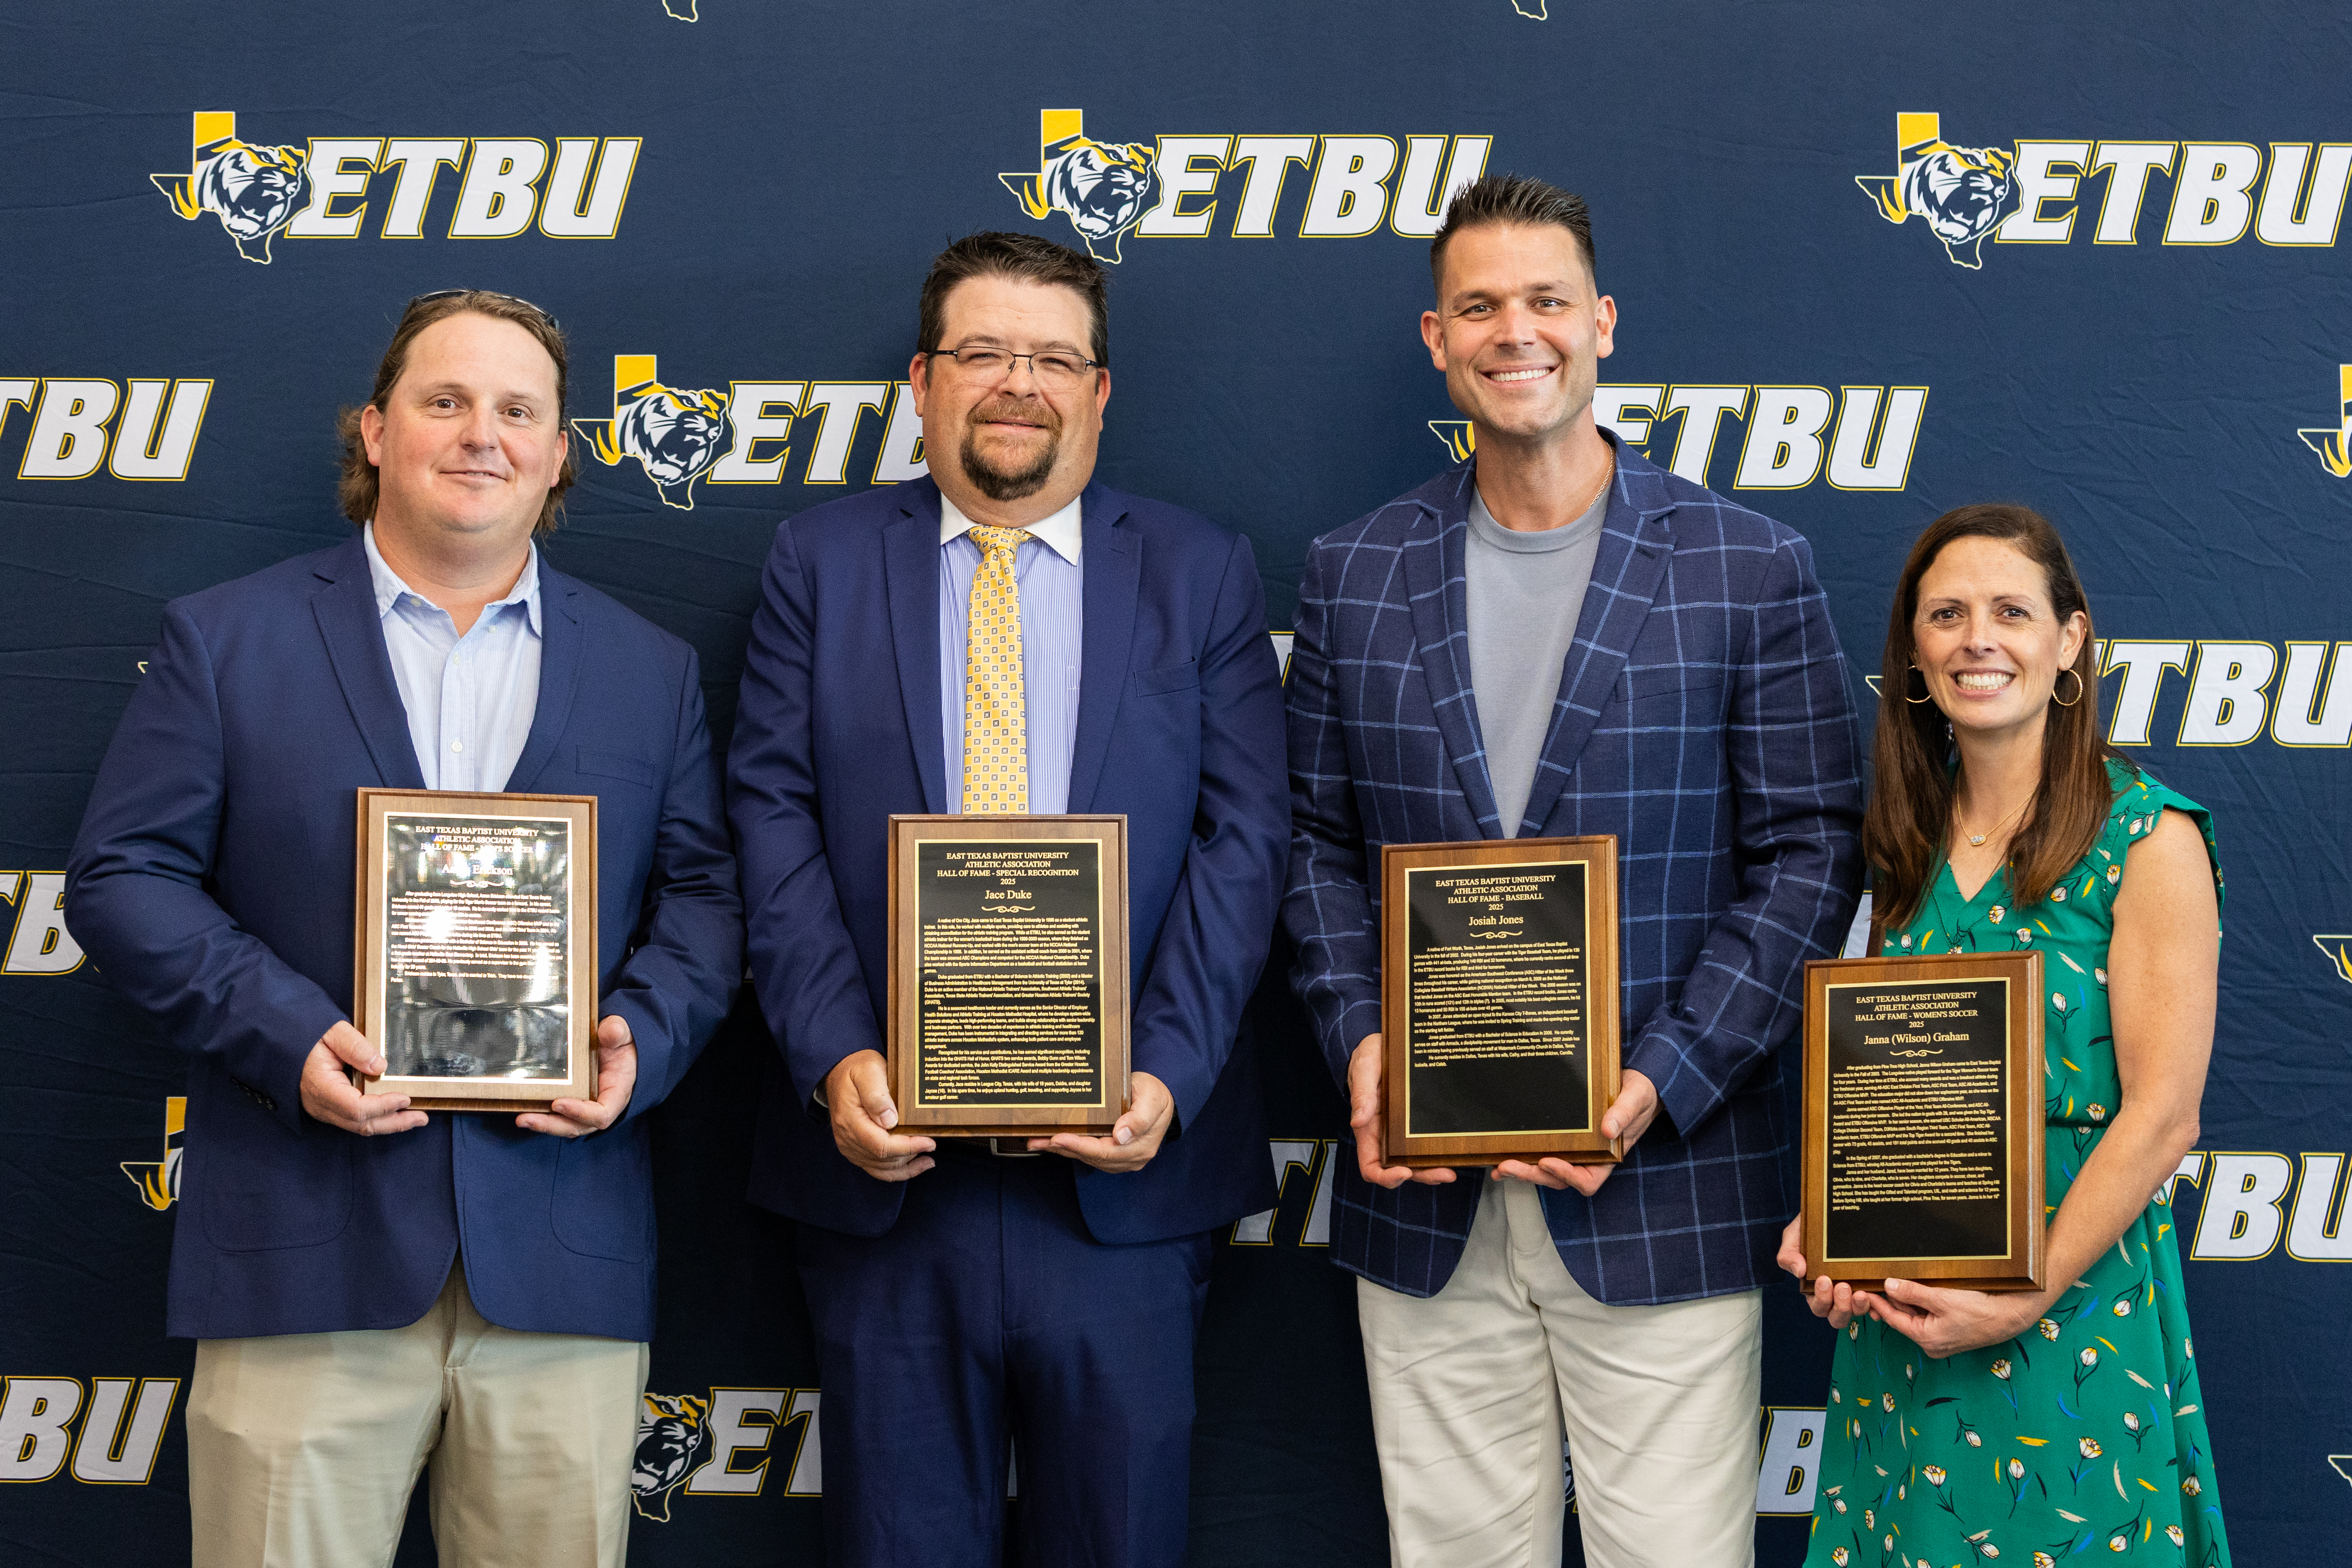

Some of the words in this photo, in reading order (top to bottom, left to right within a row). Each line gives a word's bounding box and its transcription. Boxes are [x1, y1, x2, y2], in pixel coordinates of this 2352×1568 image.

[284, 137, 643, 240] ETBU
[1135, 135, 1493, 238] ETBU
[1994, 140, 2352, 247] ETBU
[2096, 639, 2352, 748] TBU
[1455, 878, 1479, 886] TEXAS
[1480, 877, 1510, 885] BAPTIST
[1512, 875, 1556, 883] UNIVERSITY
[985, 890, 1005, 899] Jace
[1007, 890, 1032, 899] Duke
[1453, 887, 1489, 895] ATHLETIC
[1490, 884, 1538, 893] ASSOCIATION
[1505, 893, 1544, 901] BASEBALL
[1469, 916, 1496, 926] Josiah
[1499, 915, 1523, 924] Jones
[1901, 993, 1932, 1001] BAPTIST
[1932, 991, 1976, 1000] UNIVERSITY
[1874, 1003, 1910, 1012] ATHLETIC
[1910, 1001, 1959, 1010] ASSOCIATION
[1864, 1035, 1889, 1044] Janna
[1891, 1033, 1931, 1045] (Wilson)
[1933, 1032, 1969, 1042] Graham
[0, 1376, 181, 1484] BU
